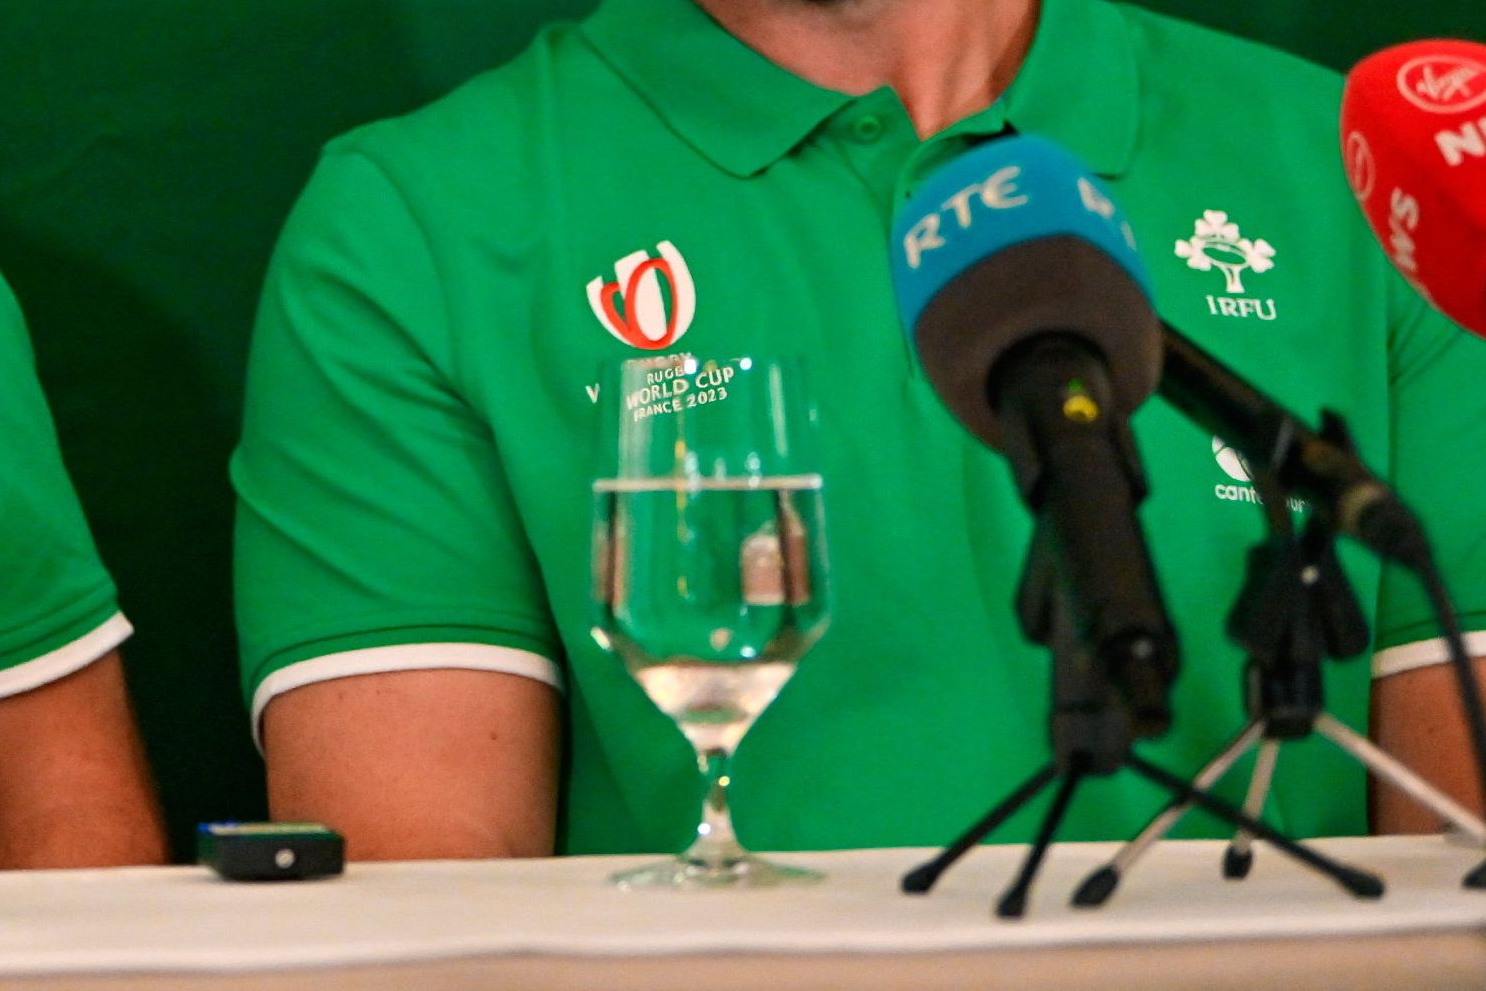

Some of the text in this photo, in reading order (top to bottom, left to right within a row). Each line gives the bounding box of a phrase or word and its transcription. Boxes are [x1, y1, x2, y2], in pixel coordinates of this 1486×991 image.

[1205, 294, 1278, 321] IRFU
[625, 378, 689, 410] WORLD
[695, 366, 735, 389] CUP
[632, 386, 728, 422] FRANCE 2023
